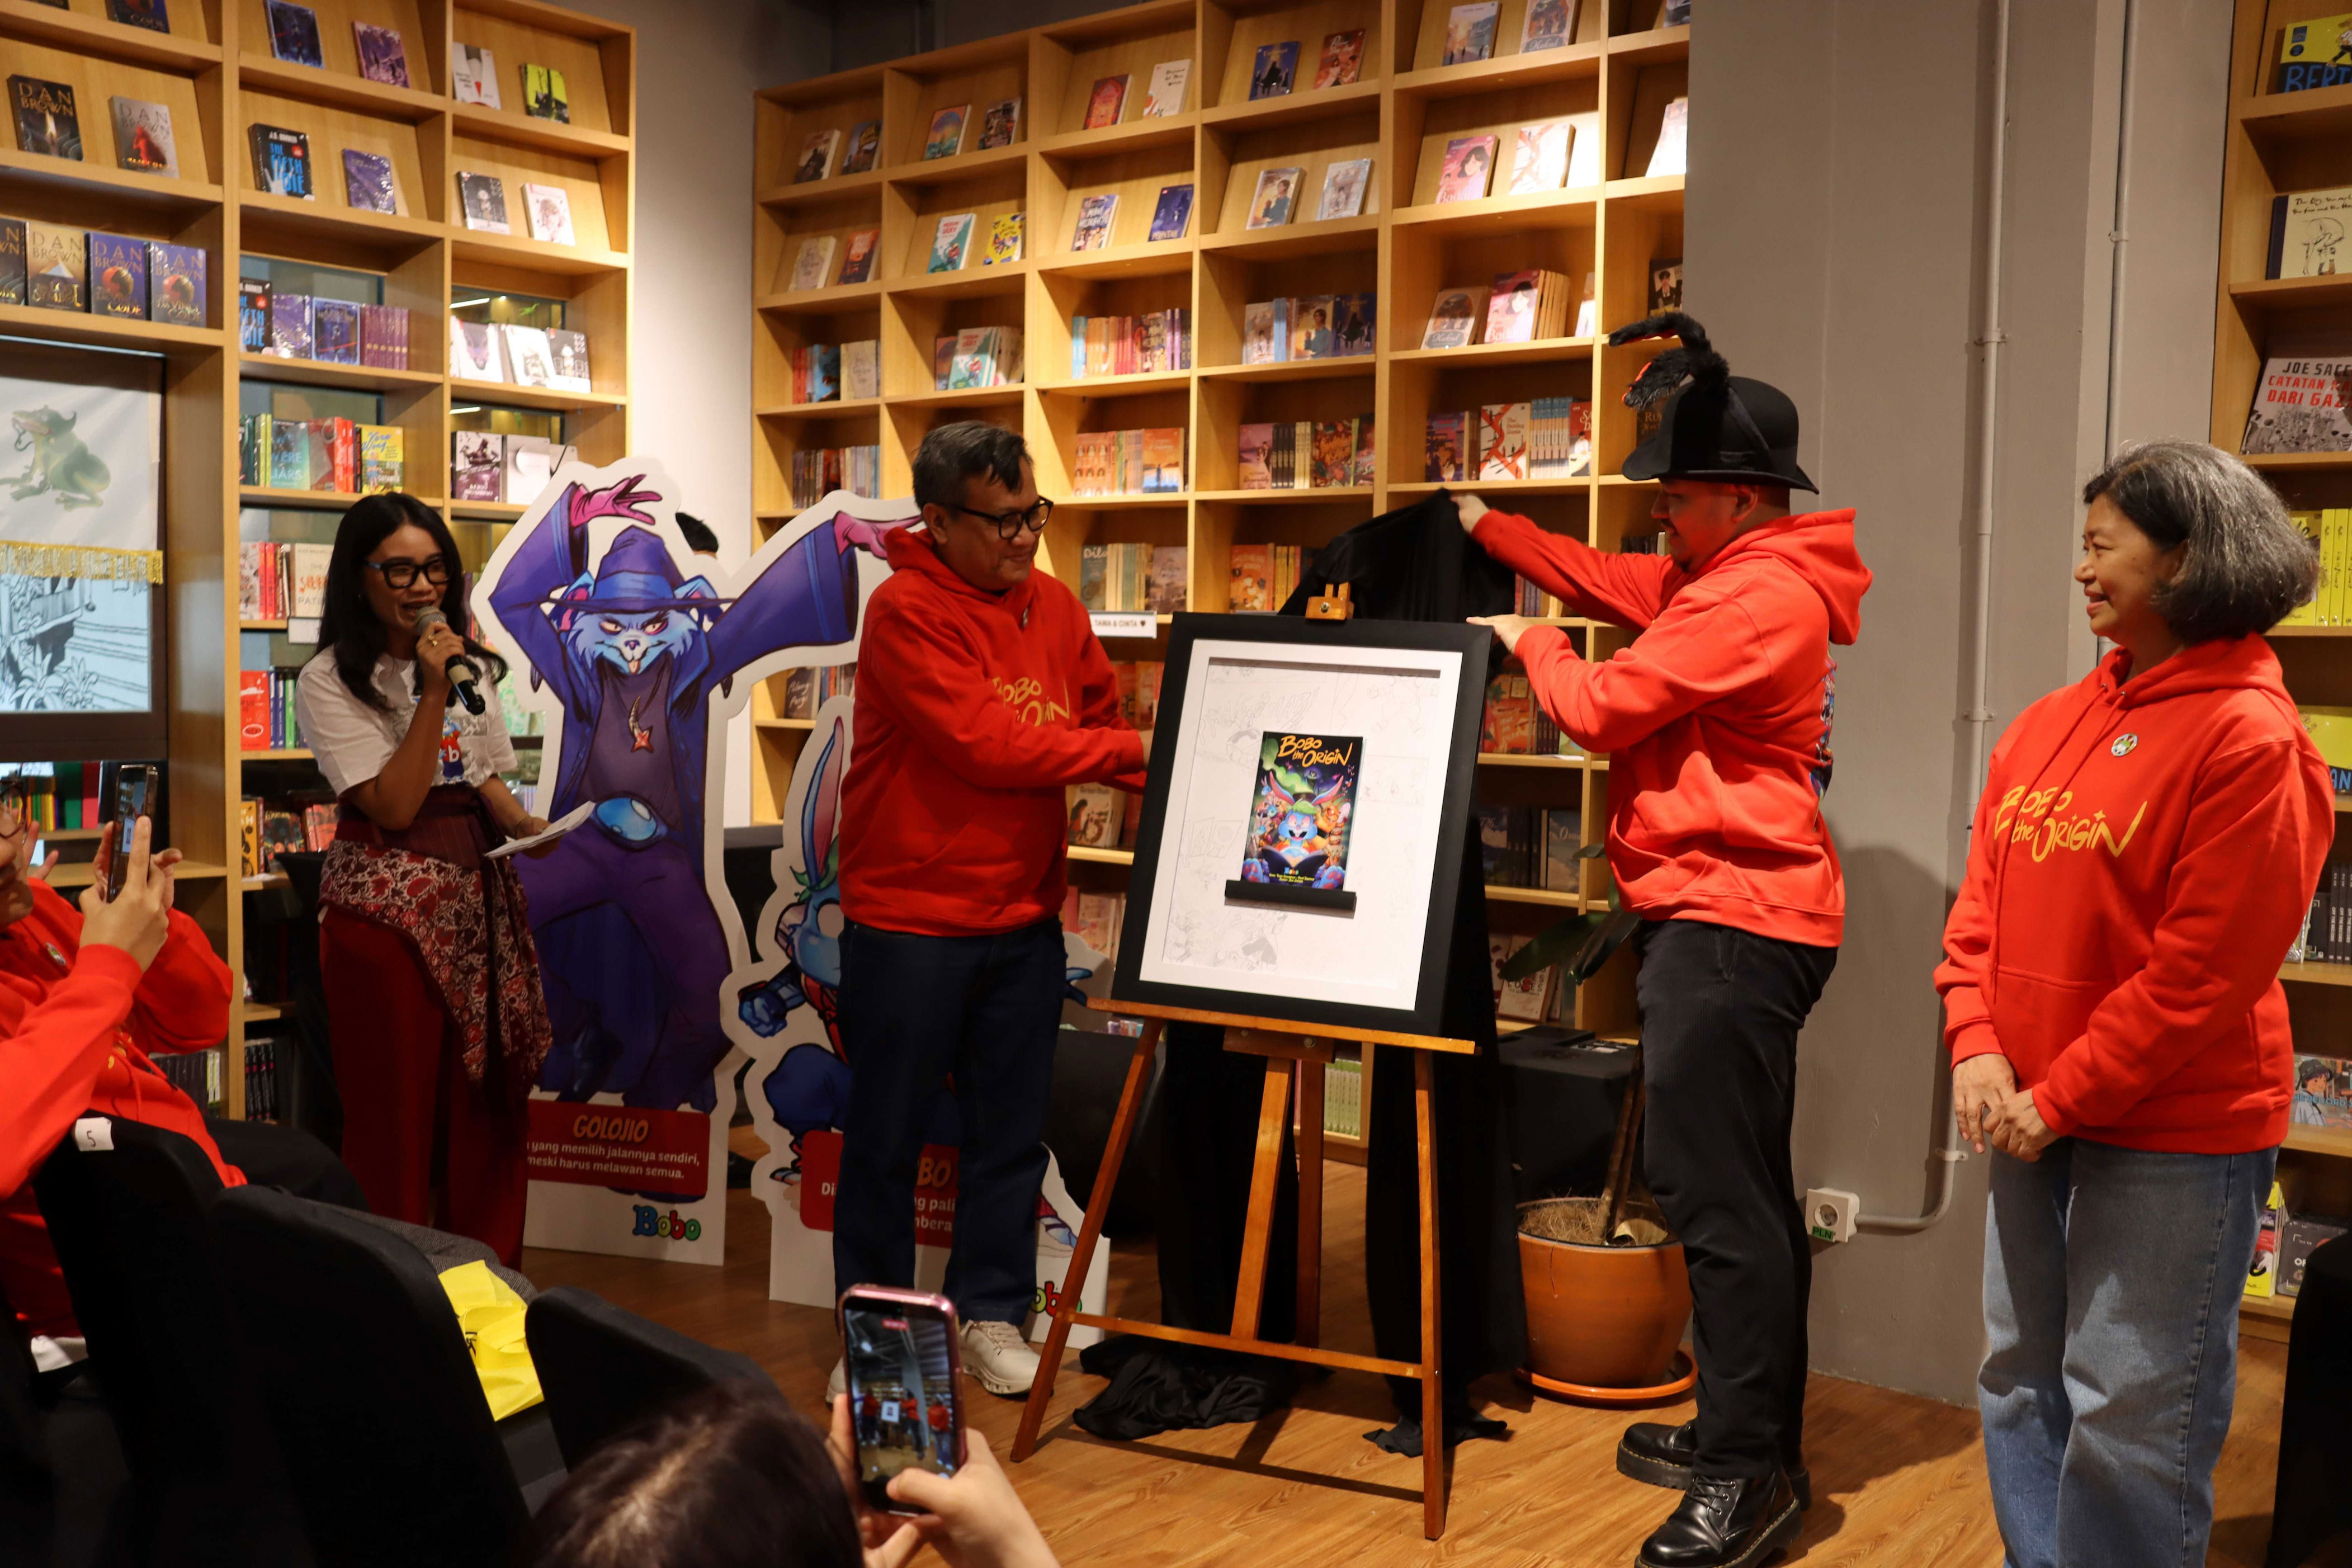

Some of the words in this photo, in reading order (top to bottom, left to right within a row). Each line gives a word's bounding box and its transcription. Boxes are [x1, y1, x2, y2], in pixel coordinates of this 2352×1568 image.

[18, 82, 72, 105] DAN
[20, 96, 74, 116] BROWN
[32, 231, 82, 252] DAN
[94, 241, 142, 261] DAN
[94, 256, 142, 274] BROWN
[156, 253, 204, 269] DAN
[2282, 361, 2311, 375] JOE
[2268, 375, 2326, 390] CATATAN
[2267, 389, 2304, 405] DARI
[448, 745, 460, 763] b
[1292, 750, 1304, 761] the
[2011, 818, 2034, 843] the
[87, 1130, 96, 1147] 5
[573, 1114, 649, 1143] GOLOJIO
[532, 1141, 559, 1154] yang
[561, 1143, 606, 1157] memilih
[606, 1146, 656, 1163] jalannya
[658, 1152, 700, 1166] sendiri,
[527, 1156, 558, 1168] meski
[559, 1158, 591, 1171] harus
[593, 1161, 643, 1176] melawan
[645, 1167, 685, 1179] semua.
[916, 1156, 952, 1188] BO
[929, 1197, 956, 1212] pali
[632, 1204, 702, 1241] Bobo
